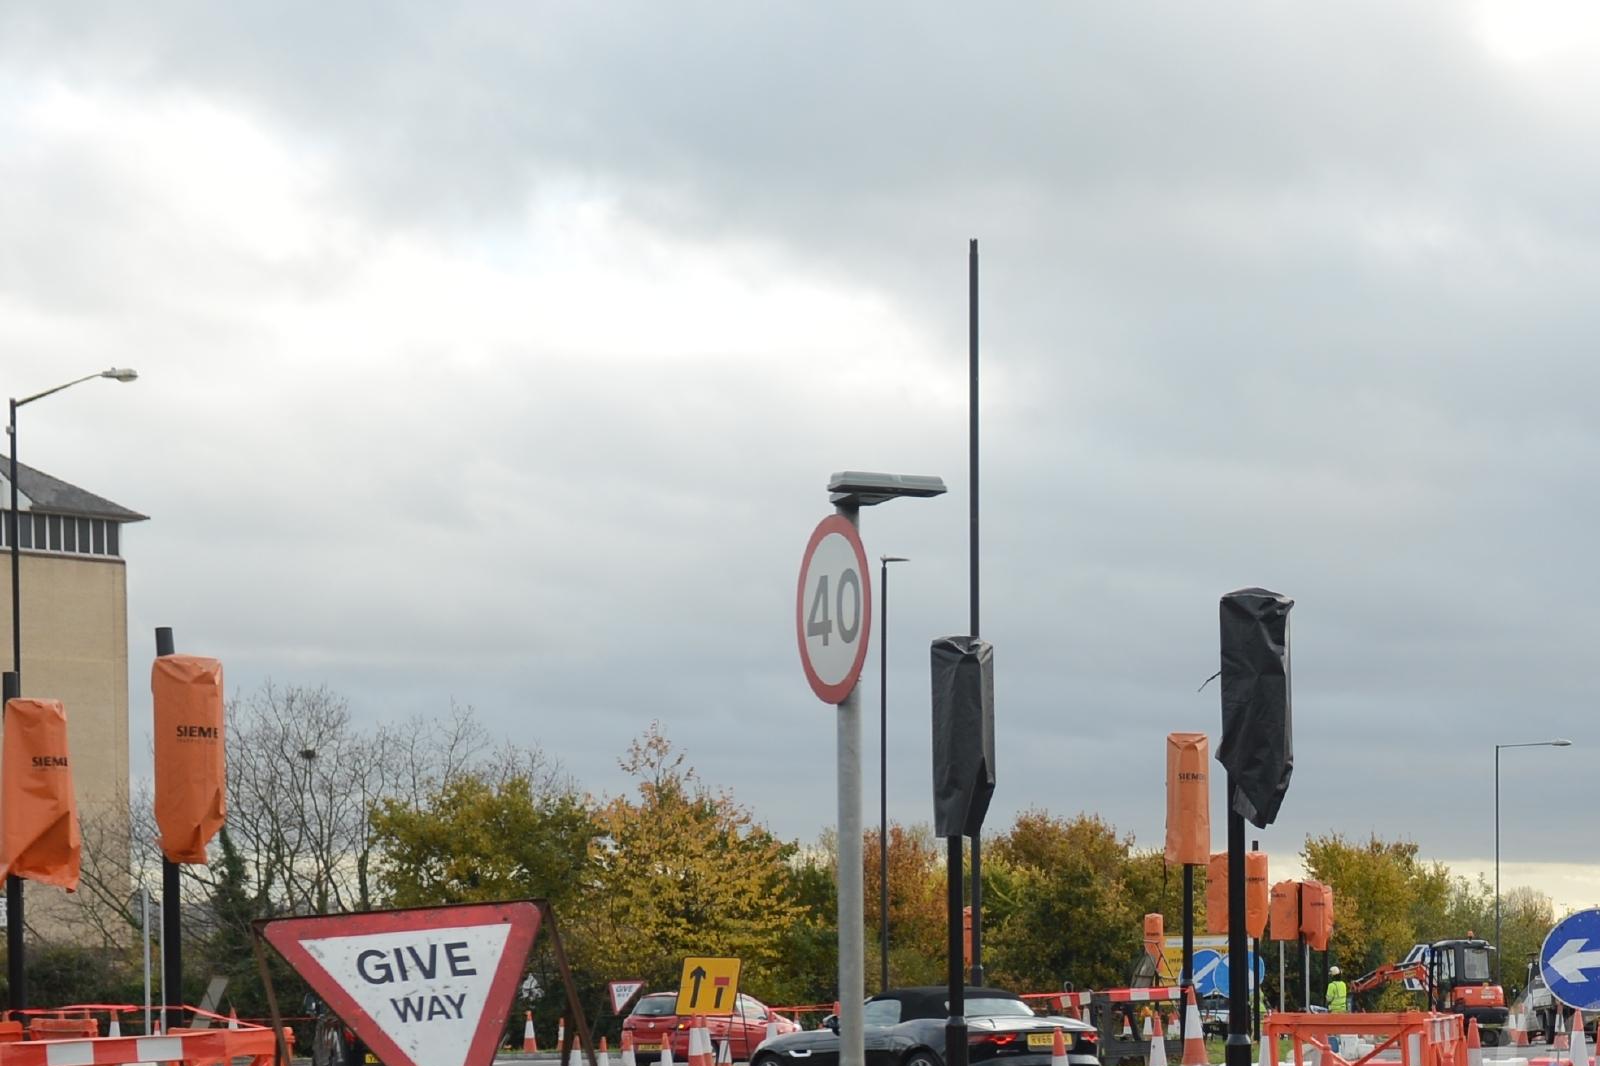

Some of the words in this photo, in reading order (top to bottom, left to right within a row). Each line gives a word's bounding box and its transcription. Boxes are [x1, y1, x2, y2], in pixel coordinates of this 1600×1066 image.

[807, 568, 860, 647] 40
[357, 942, 477, 985] GIVE
[390, 993, 466, 1022] WAY
